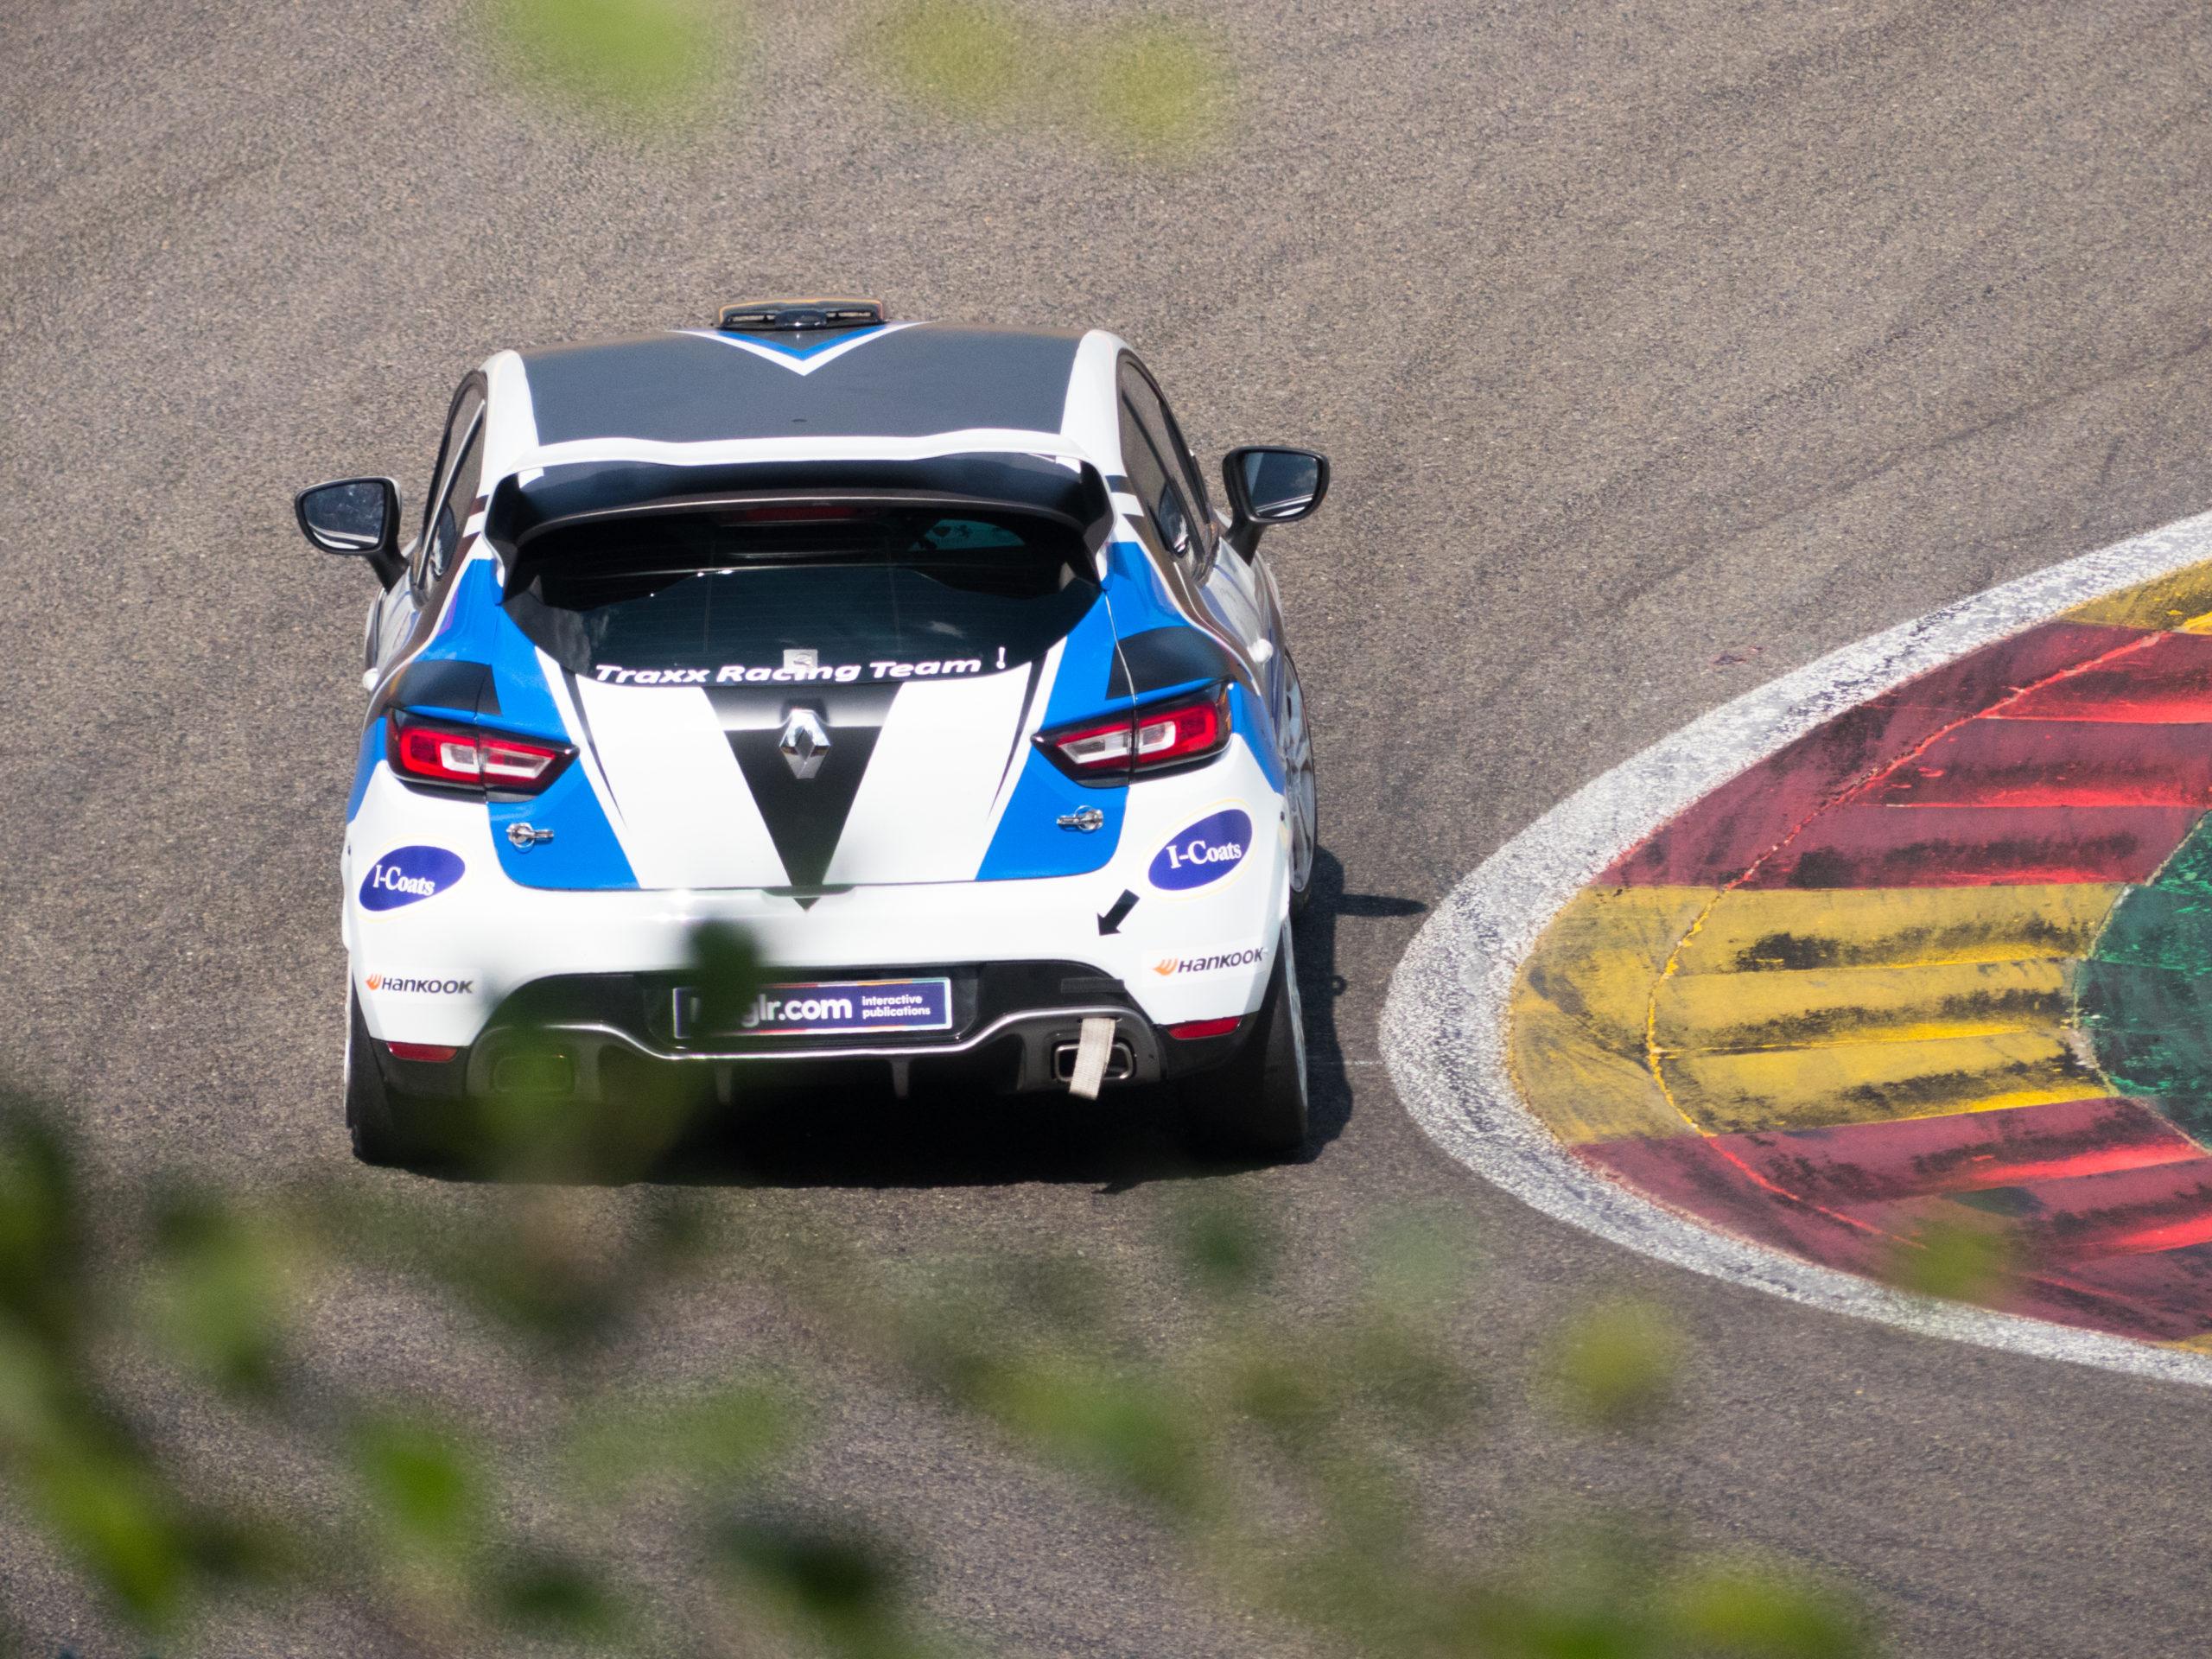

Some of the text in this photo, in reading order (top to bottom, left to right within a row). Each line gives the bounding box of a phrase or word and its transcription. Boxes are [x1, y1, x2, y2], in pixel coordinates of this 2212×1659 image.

[595, 664, 709, 684] Traxx
[715, 663, 862, 683] Racing
[868, 658, 982, 679] Team
[1166, 840, 1243, 869] I-Coats
[372, 864, 436, 897] I-Coats
[861, 994, 924, 1007] interactive
[862, 1005, 932, 1020] publications
